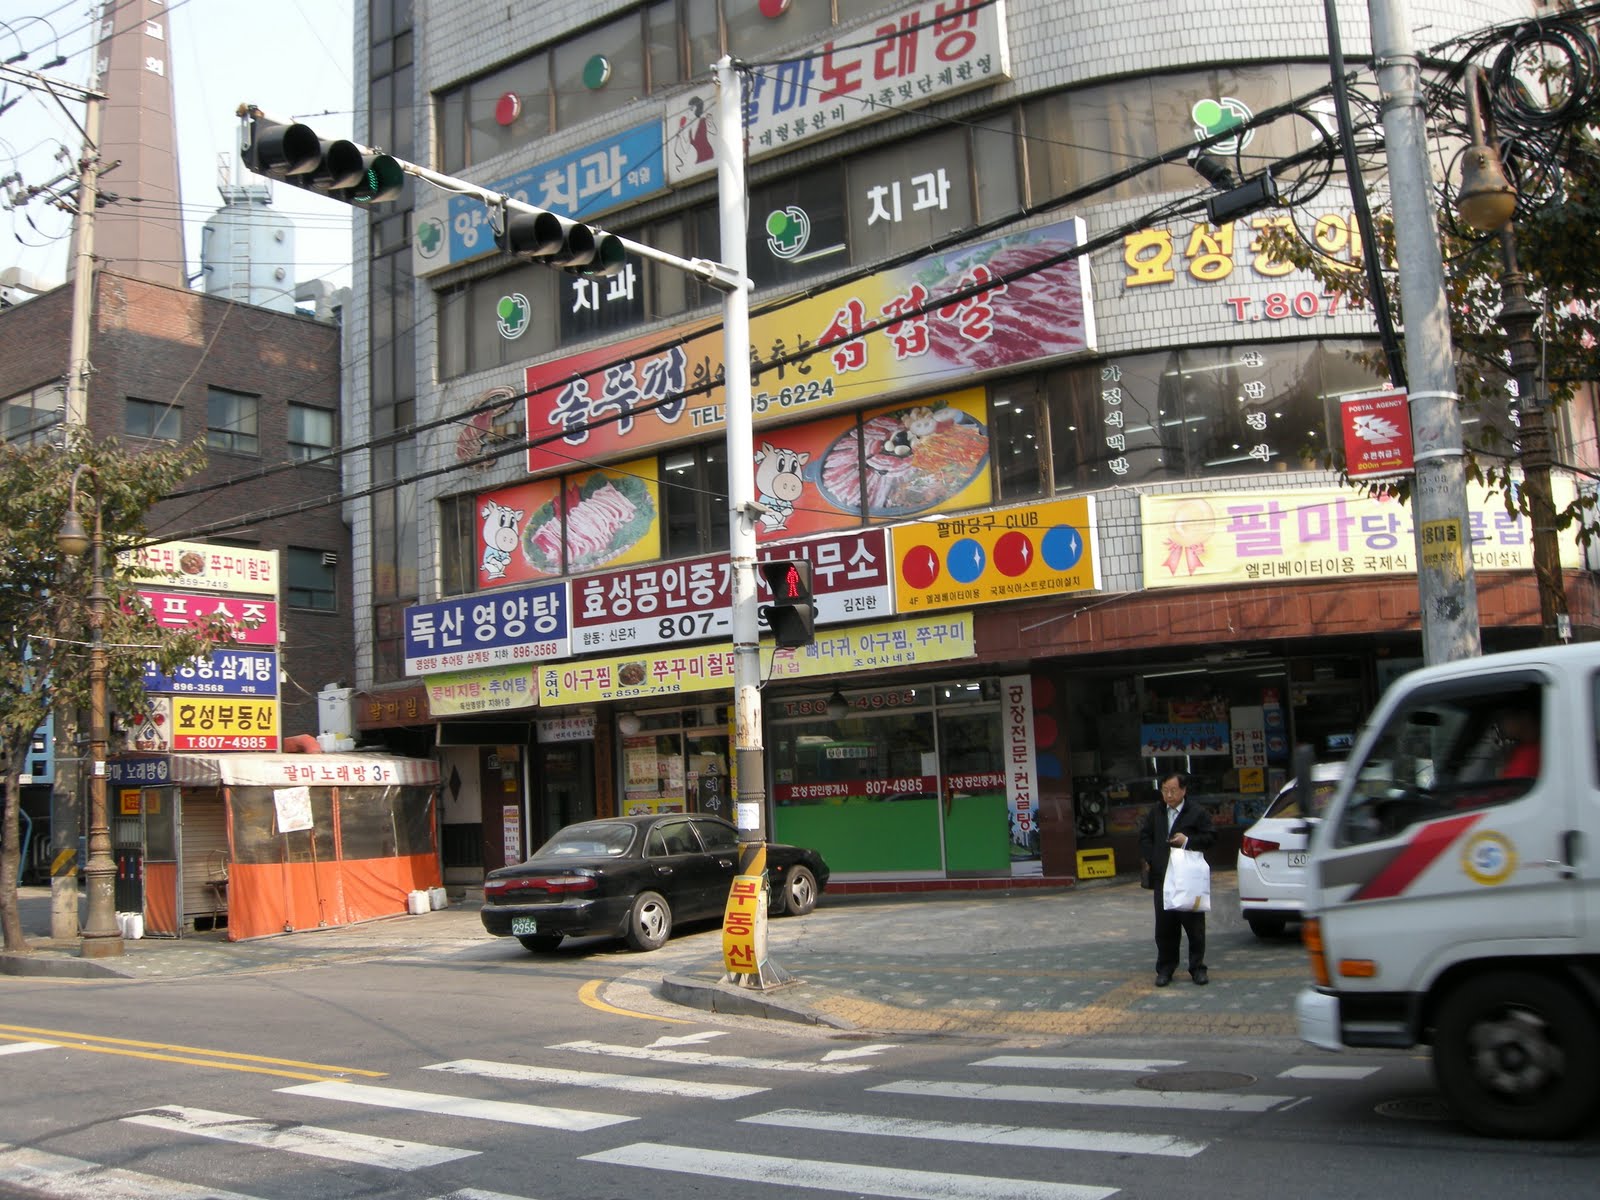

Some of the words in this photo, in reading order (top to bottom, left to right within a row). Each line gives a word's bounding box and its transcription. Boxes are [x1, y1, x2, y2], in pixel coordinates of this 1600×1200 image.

[538, 144, 628, 214] 치과
[867, 168, 951, 227] 치과
[572, 263, 637, 314] 치과
[818, 263, 1007, 374] 삼겹살
[1348, 403, 1374, 413] POSTAL
[1376, 399, 1403, 409] AGENCY
[1101, 364, 1130, 476] 가정식백반
[937, 515, 996, 539] 팔마당구
[1006, 511, 1039, 529] CLUB
[1363, 552, 1408, 572] 국제식
[180, 577, 229, 589] 859-7418
[411, 606, 465, 649] 독산
[472, 591, 560, 642] 영양탕
[609, 626, 637, 643] 신은자
[843, 594, 877, 612] 김진한
[916, 621, 965, 646] 쭈꾸미
[494, 649, 509, 660] 지하
[173, 682, 224, 693] 896-3568
[545, 670, 560, 698] 조여사
[564, 665, 611, 691] 아구찜
[616, 684, 681, 698] 859-7418
[784, 690, 915, 716] T.80-4985
[179, 704, 273, 730] 효성부동산
[370, 697, 428, 721] 팔마빌
[187, 736, 267, 750] T.807-4985
[127, 761, 157, 780] 노래방
[373, 765, 390, 782] 3F
[865, 778, 923, 795] 807-4985
[513, 921, 537, 935] 2955
[725, 882, 757, 968] 부동산
